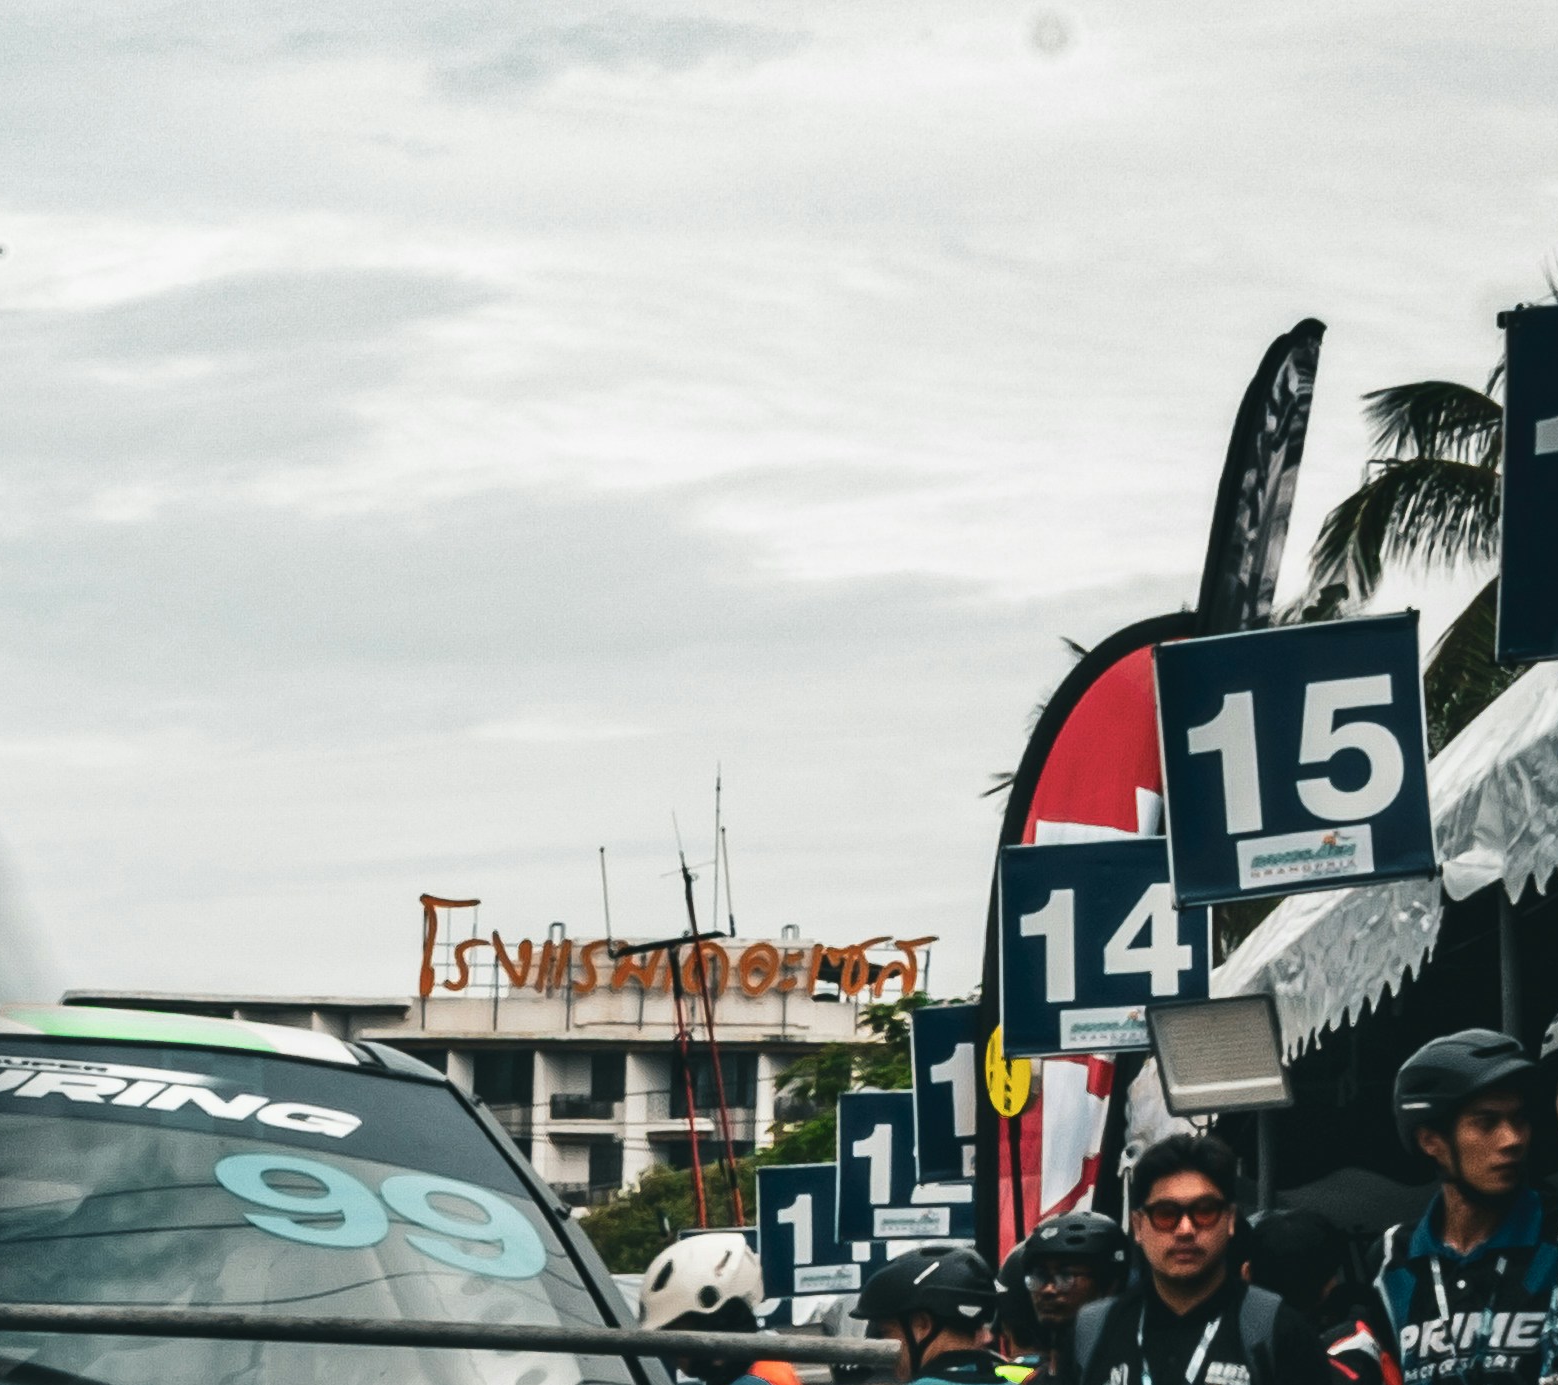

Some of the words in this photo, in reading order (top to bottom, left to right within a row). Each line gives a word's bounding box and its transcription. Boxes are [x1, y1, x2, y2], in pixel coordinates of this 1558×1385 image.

[1187, 673, 1404, 835] 15
[1020, 882, 1193, 1003] 14
[214, 1153, 547, 1279] 99
[1400, 1311, 1548, 1358] PRIME
